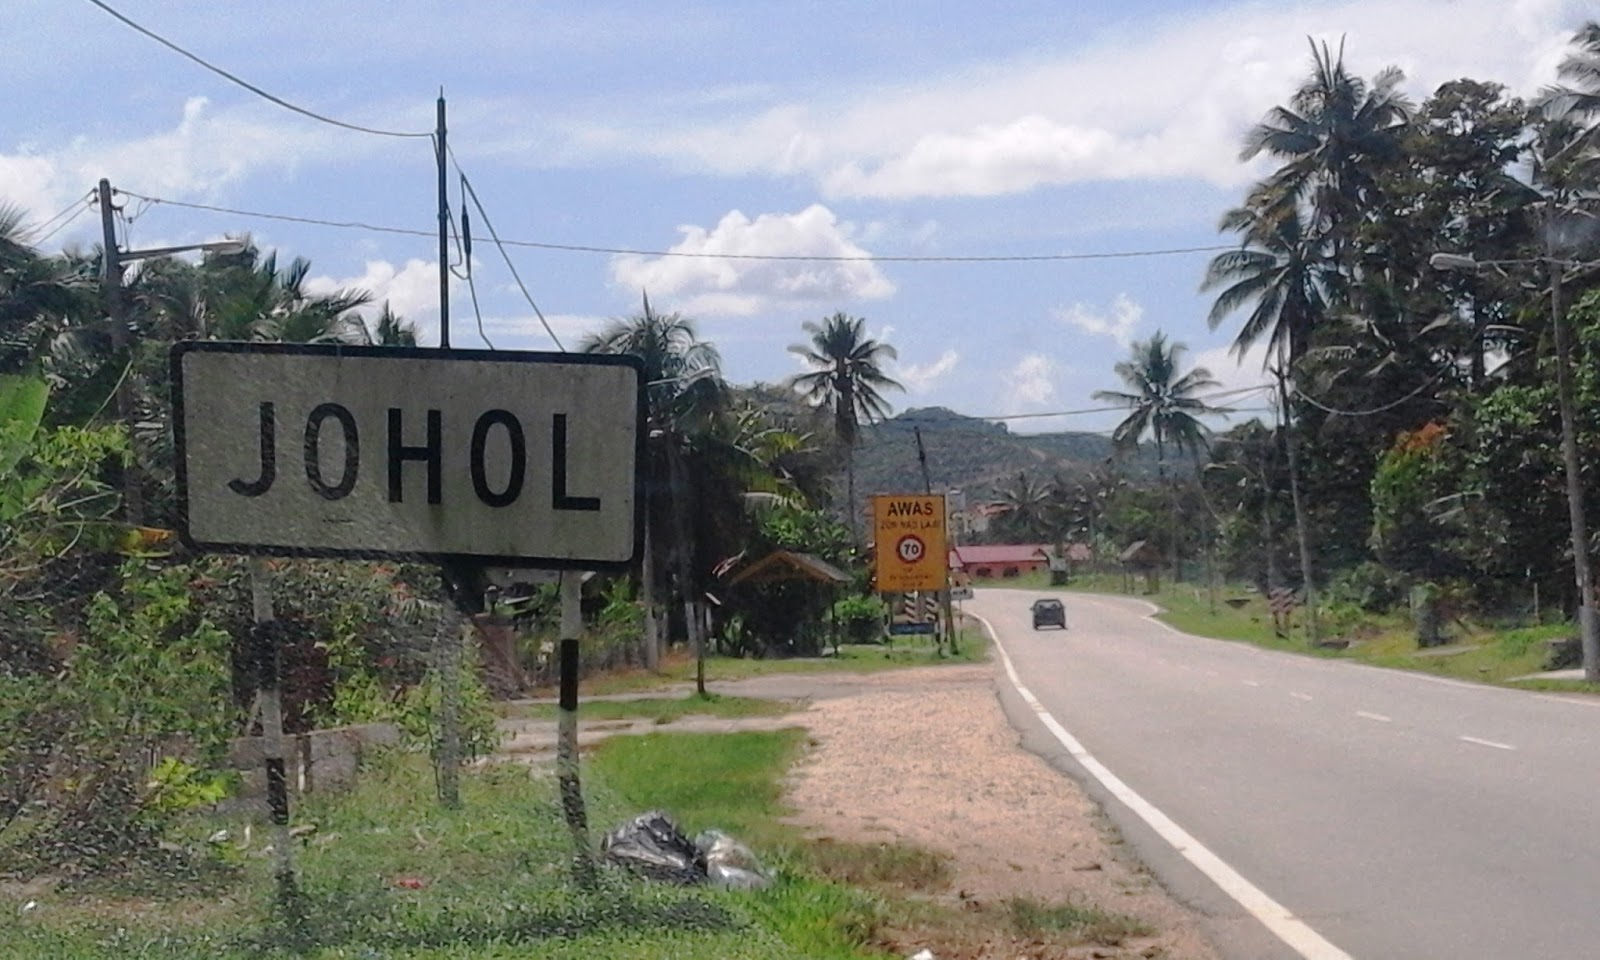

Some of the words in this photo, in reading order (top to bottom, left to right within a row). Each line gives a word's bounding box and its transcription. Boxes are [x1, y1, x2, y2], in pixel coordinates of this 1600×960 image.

[227, 401, 601, 511] JOHOL
[887, 501, 934, 517] AWAS
[903, 543, 919, 556] 70
